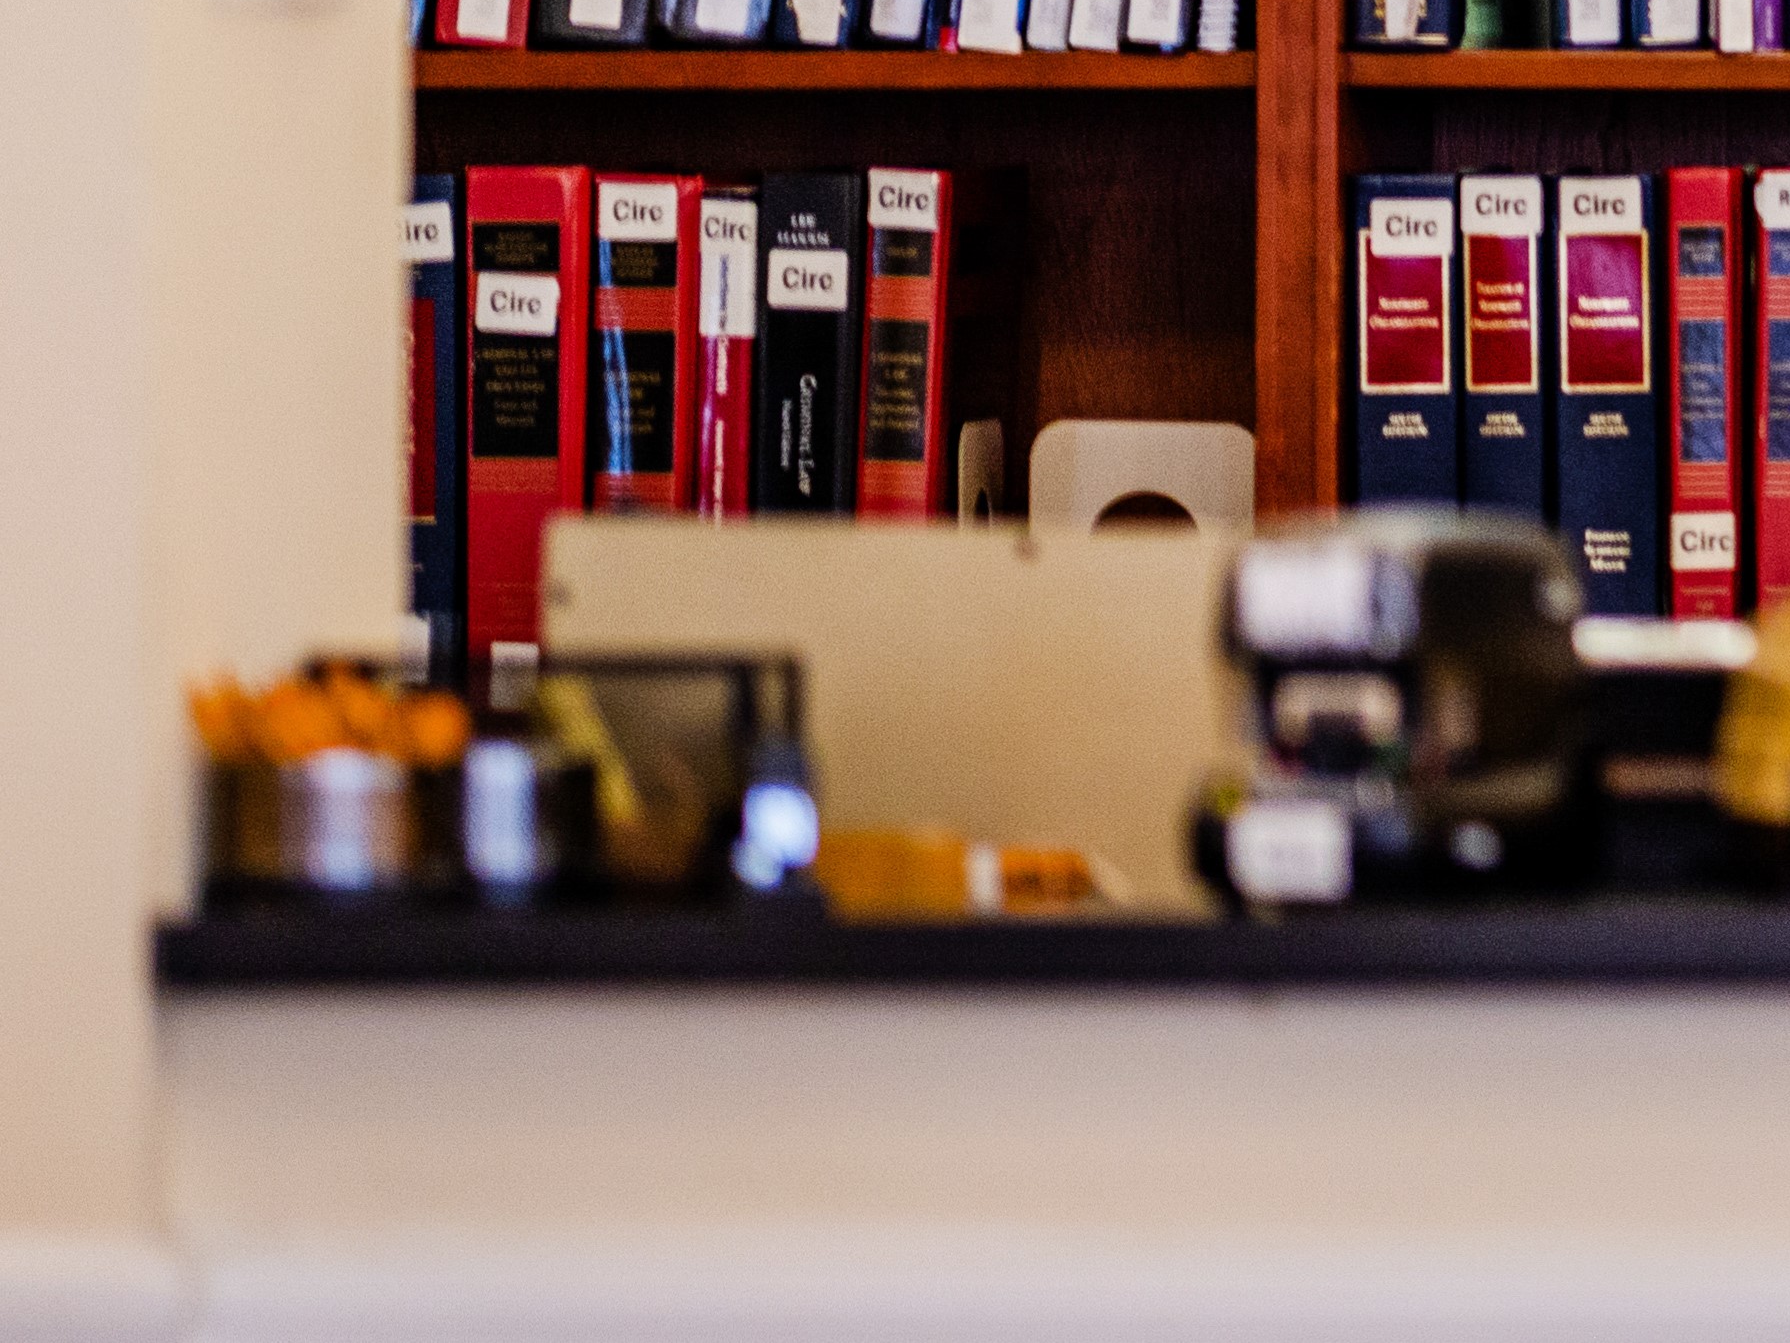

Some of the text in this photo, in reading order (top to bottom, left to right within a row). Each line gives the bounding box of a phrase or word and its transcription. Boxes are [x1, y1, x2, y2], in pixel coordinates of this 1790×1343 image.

[878, 186, 929, 210] Circ
[1475, 195, 1526, 214] Circ
[1574, 195, 1625, 214] Circ
[613, 200, 663, 221] Circ
[705, 216, 749, 240] Circ
[1386, 216, 1437, 237] Circ
[782, 267, 832, 290] Circ
[490, 291, 541, 314] Circ
[1680, 531, 1732, 552] Circ
